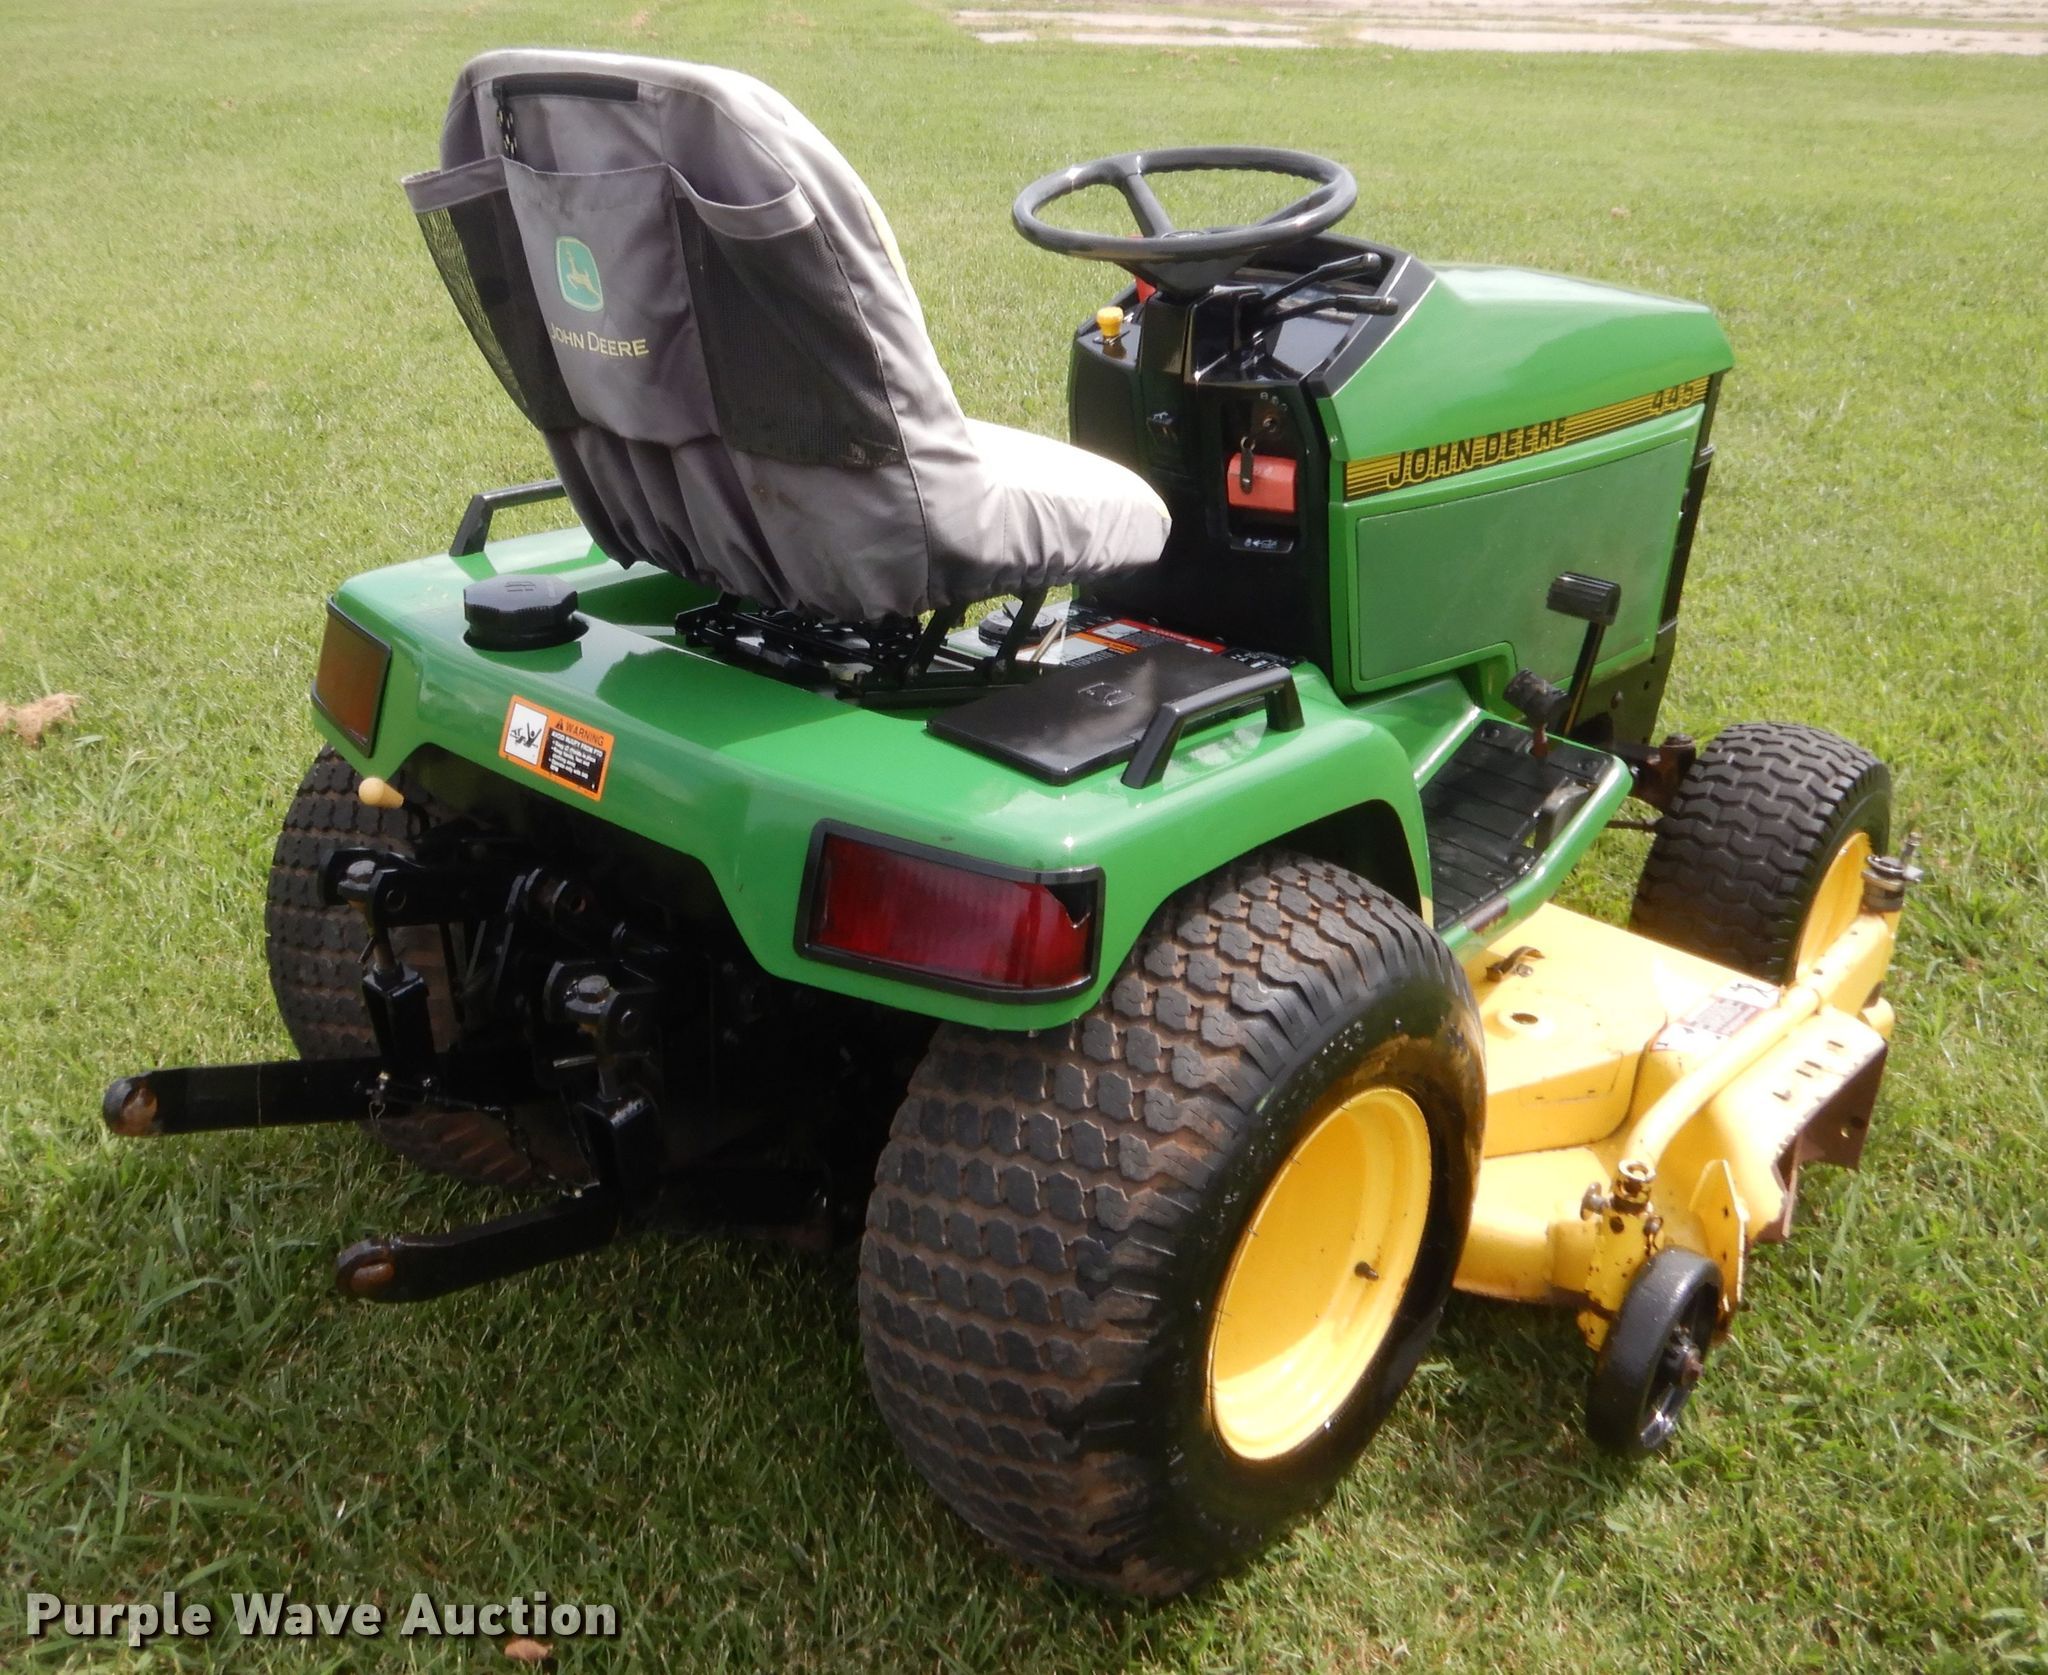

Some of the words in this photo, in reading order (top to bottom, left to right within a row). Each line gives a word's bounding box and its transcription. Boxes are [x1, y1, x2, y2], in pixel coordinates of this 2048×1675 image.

[550, 322, 585, 349] JOHN
[586, 331, 649, 357] DEERE
[1651, 383, 1694, 411] 445
[1387, 437, 1475, 488] JOHN
[1482, 417, 1567, 465] DEERE
[565, 721, 605, 747] WARNING
